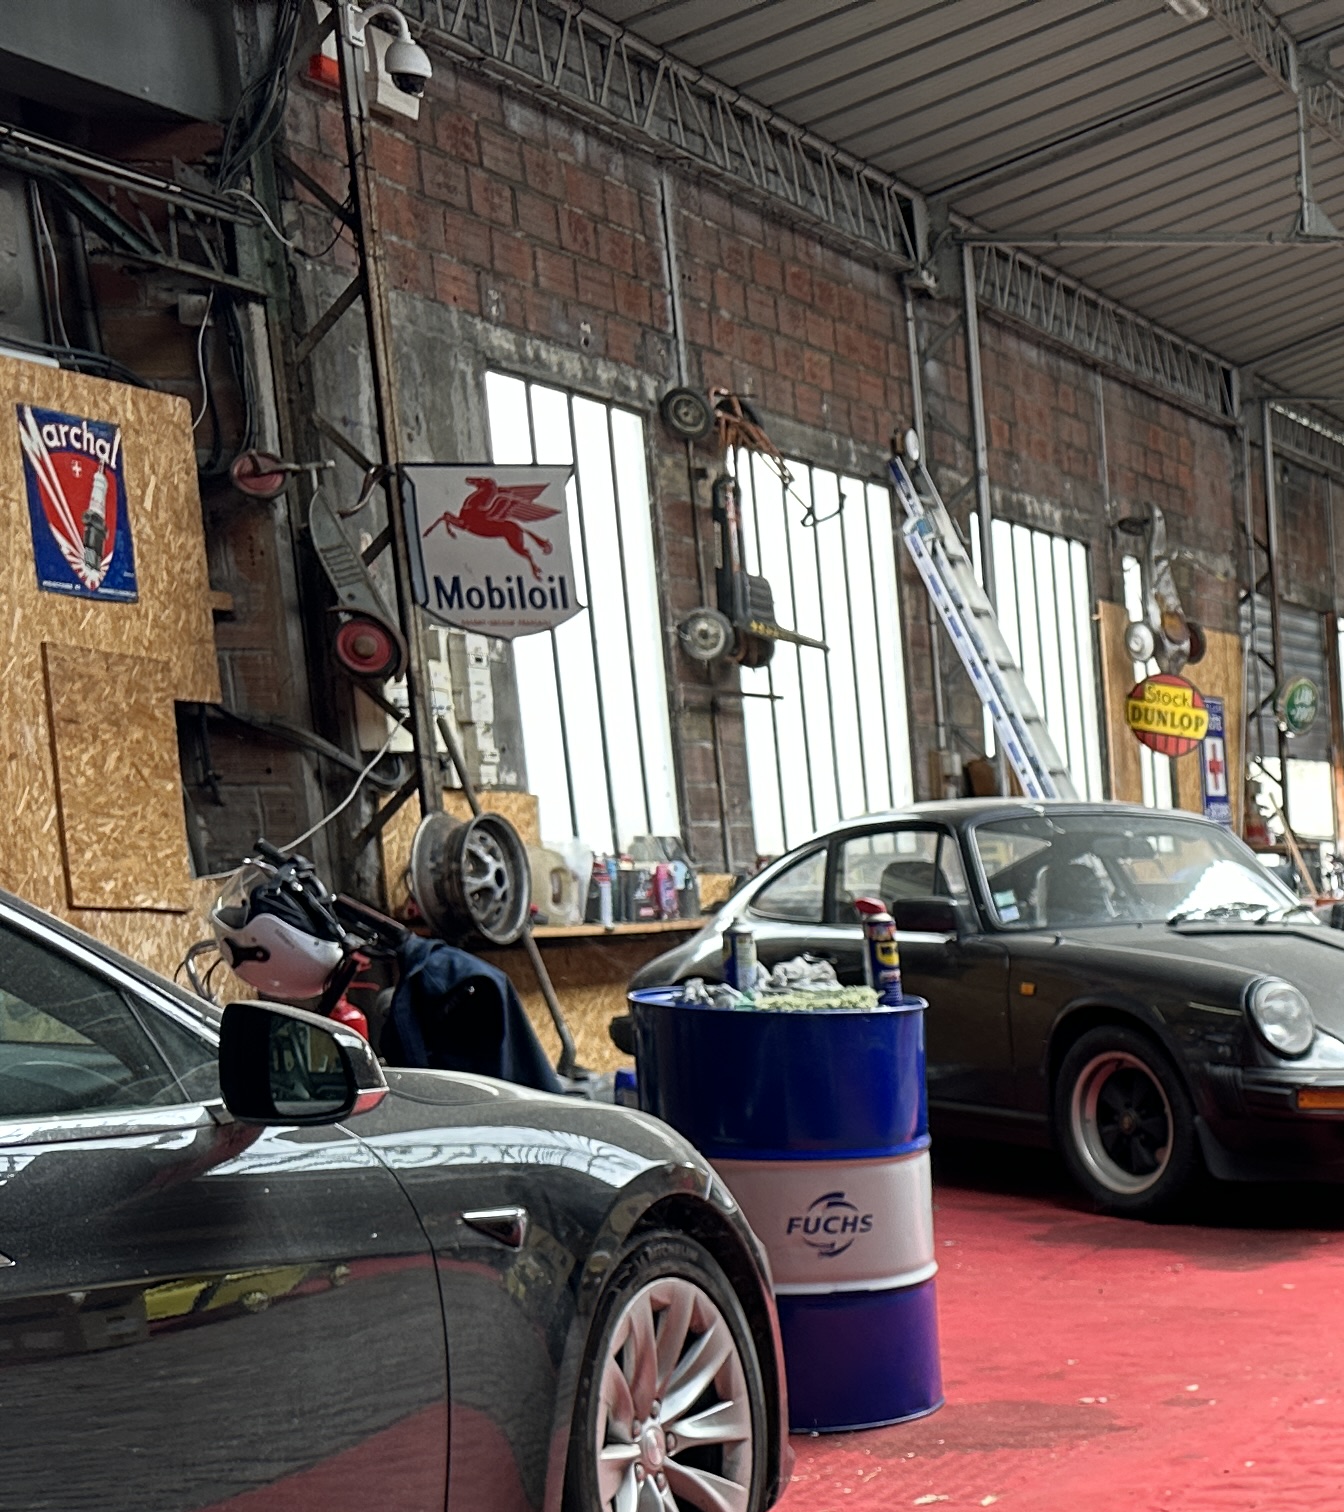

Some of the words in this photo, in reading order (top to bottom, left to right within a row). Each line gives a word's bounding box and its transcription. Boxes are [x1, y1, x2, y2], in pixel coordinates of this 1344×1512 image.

[433, 575, 570, 610] Mobiloil
[1146, 684, 1192, 709] Stock
[1130, 705, 1205, 733] DUNLOP
[786, 1214, 874, 1235] FUCHS
